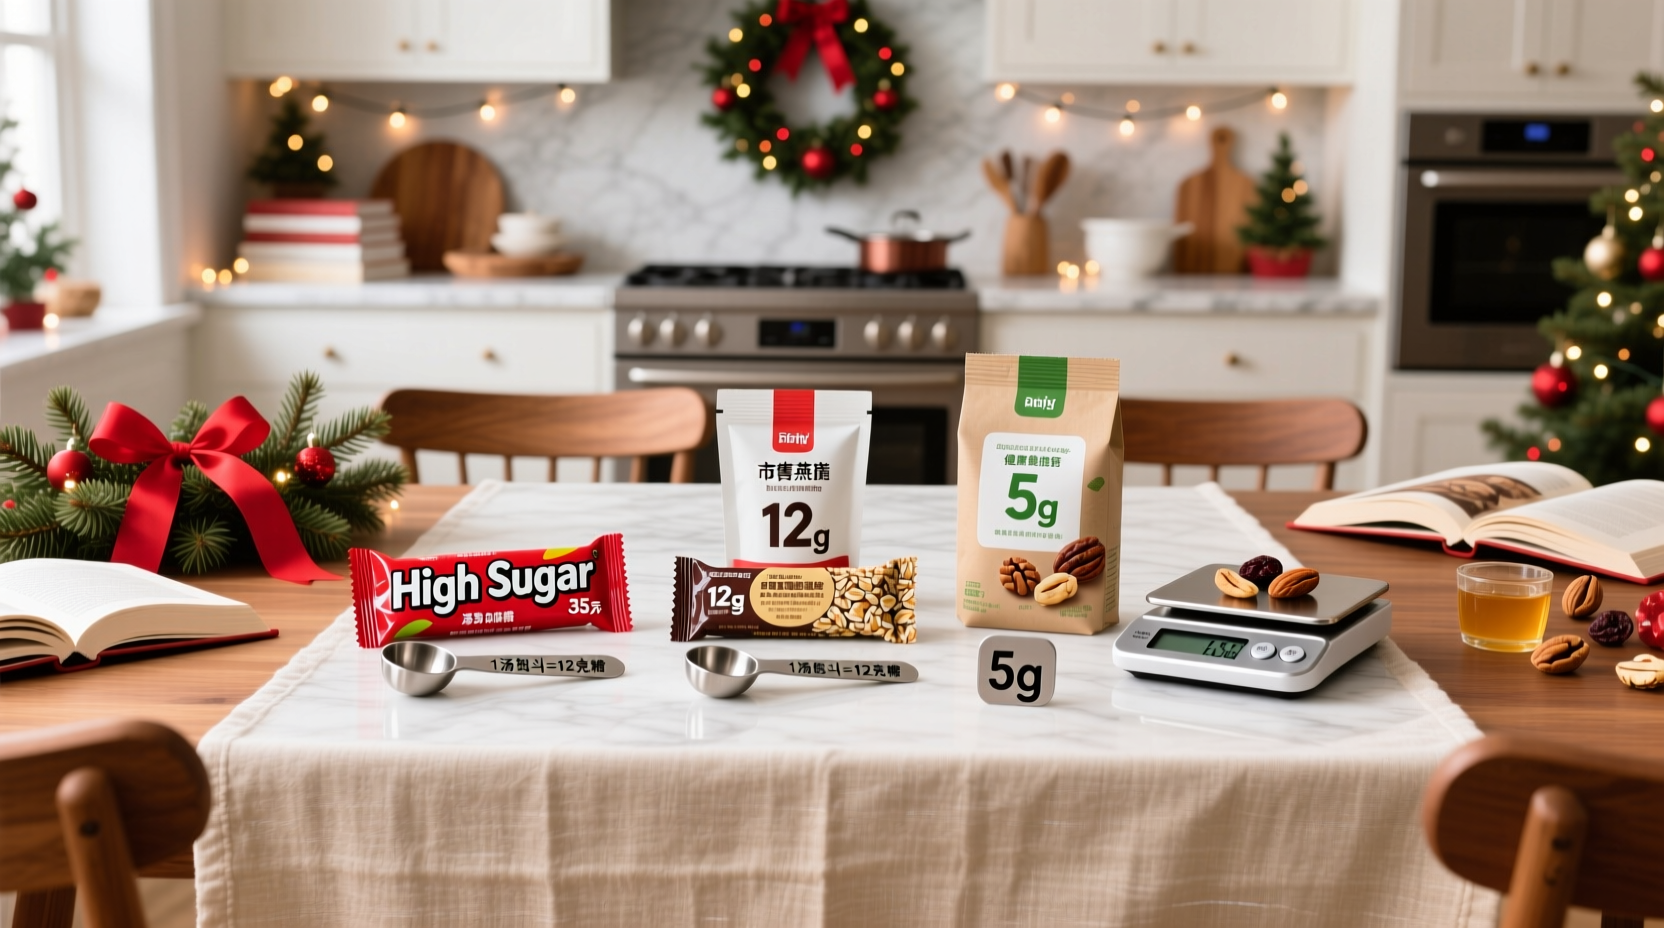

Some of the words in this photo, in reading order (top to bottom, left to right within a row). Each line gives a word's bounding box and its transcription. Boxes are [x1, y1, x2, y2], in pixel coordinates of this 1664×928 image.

[1004, 472, 1059, 528] 5g
[761, 501, 830, 555] 12g
[391, 562, 480, 614] High
[487, 560, 594, 604] Sugar
[707, 585, 745, 615] 12g
[988, 650, 1042, 703] 5g
